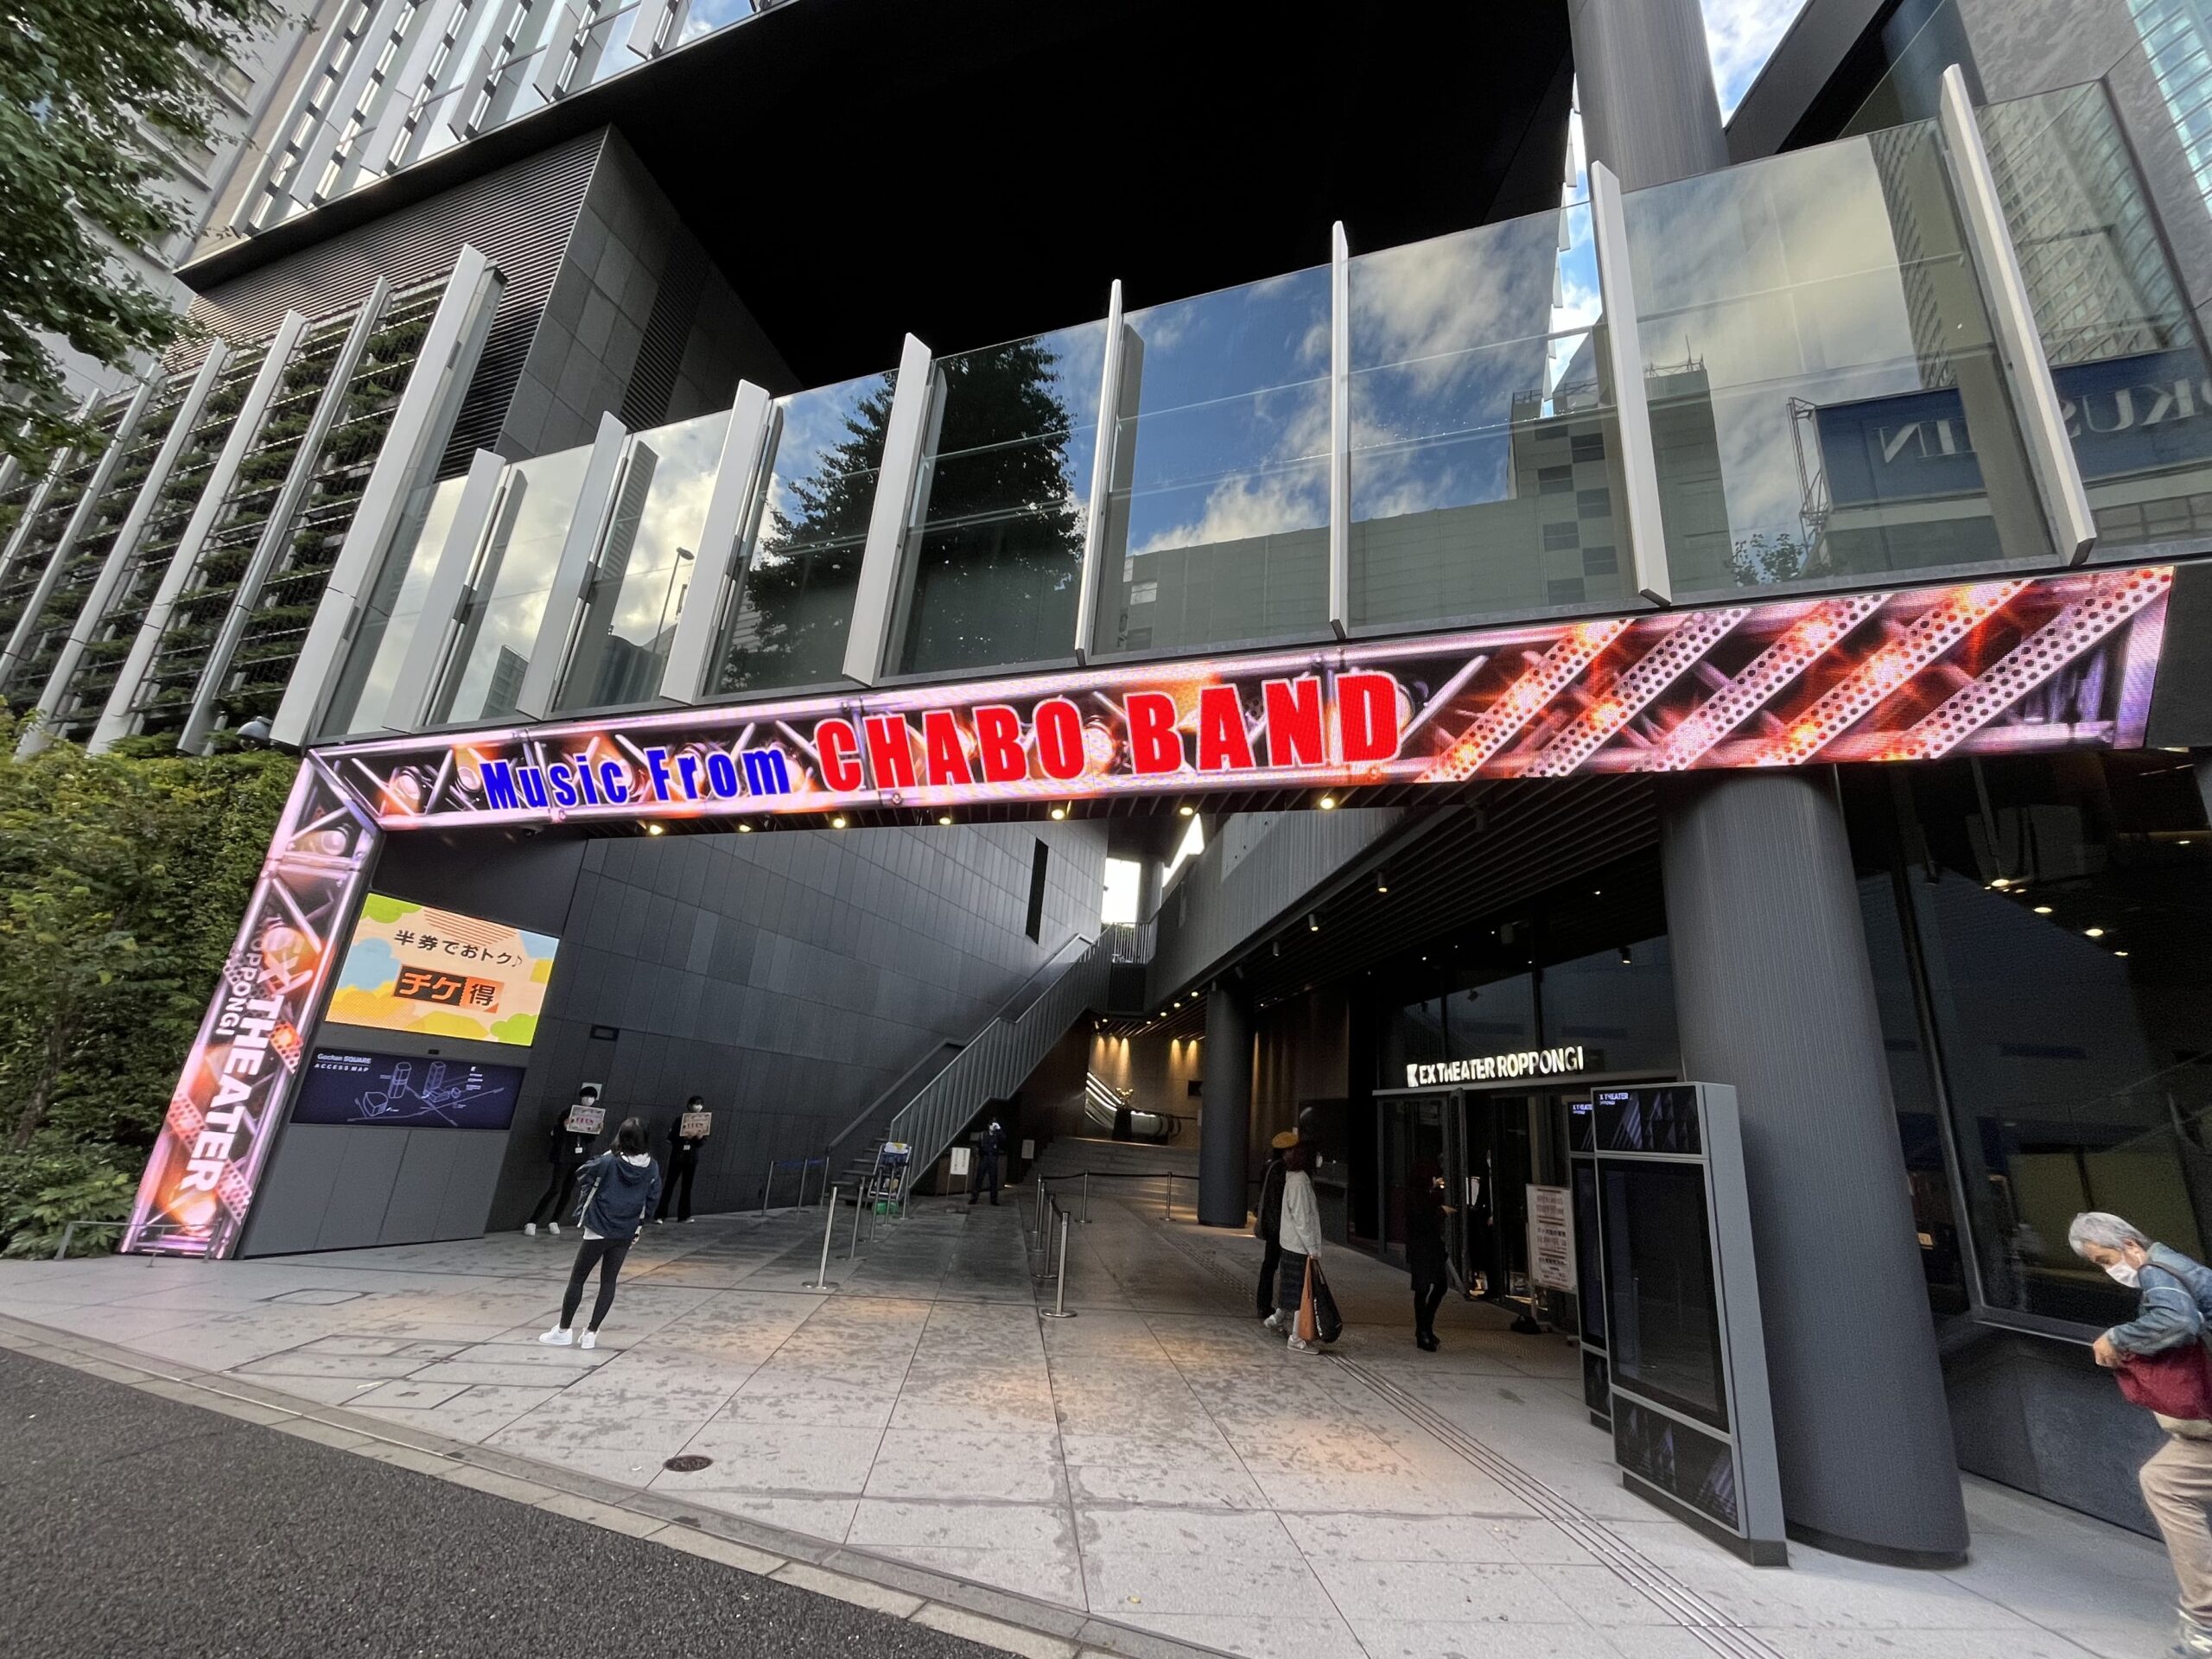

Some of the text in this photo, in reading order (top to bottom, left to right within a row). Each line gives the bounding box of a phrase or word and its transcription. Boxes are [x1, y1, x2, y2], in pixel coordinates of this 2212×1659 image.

[480, 671, 1402, 810] Music From CHABO BAND
[215, 929, 265, 1036] OPPONGI
[399, 972, 496, 1007] チケ得
[180, 995, 284, 1192] THEATER
[1436, 1057, 1496, 1084] THEATER
[1497, 1046, 1585, 1078] ROPPONGI
